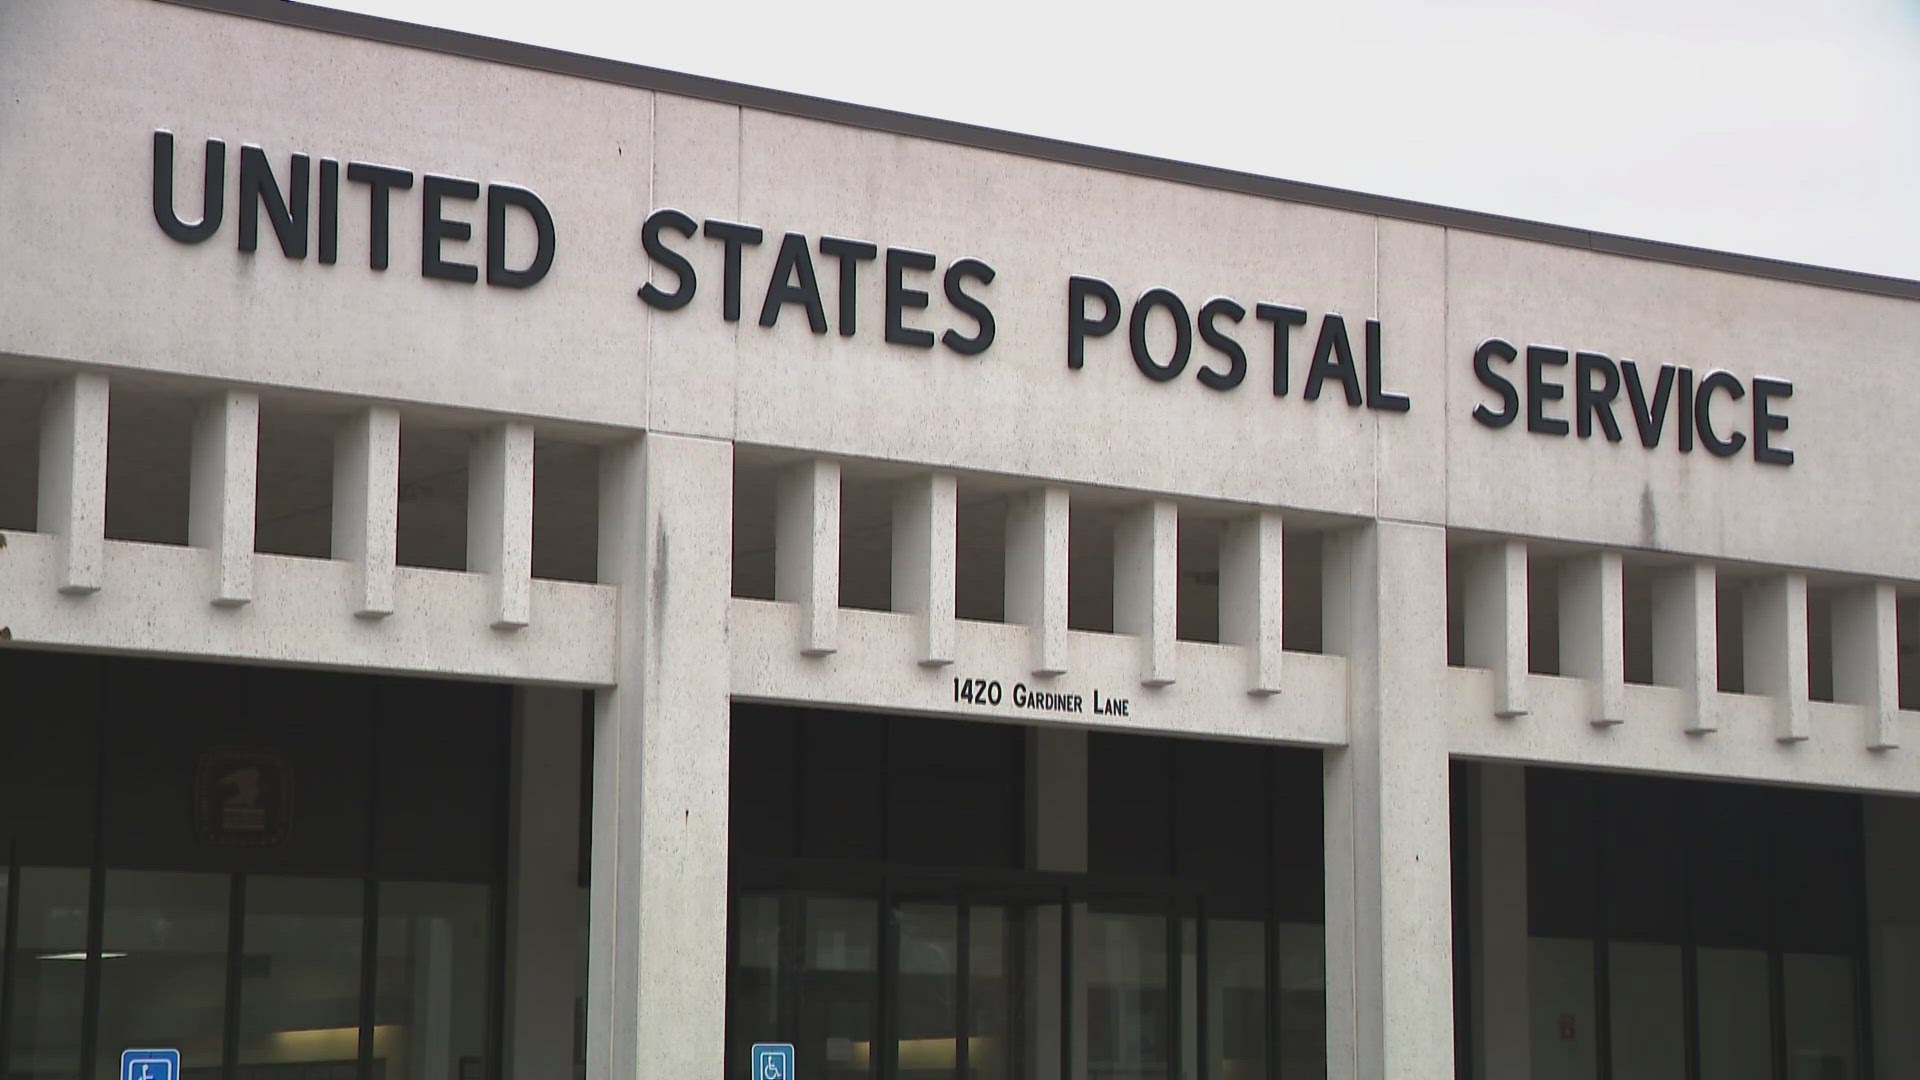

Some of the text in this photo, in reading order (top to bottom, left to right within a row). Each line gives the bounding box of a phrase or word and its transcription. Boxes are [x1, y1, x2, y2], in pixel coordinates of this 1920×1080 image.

[153, 131, 1794, 467] UNITED STATES POSTAL SERVICE
[953, 677, 1002, 706] 1420
